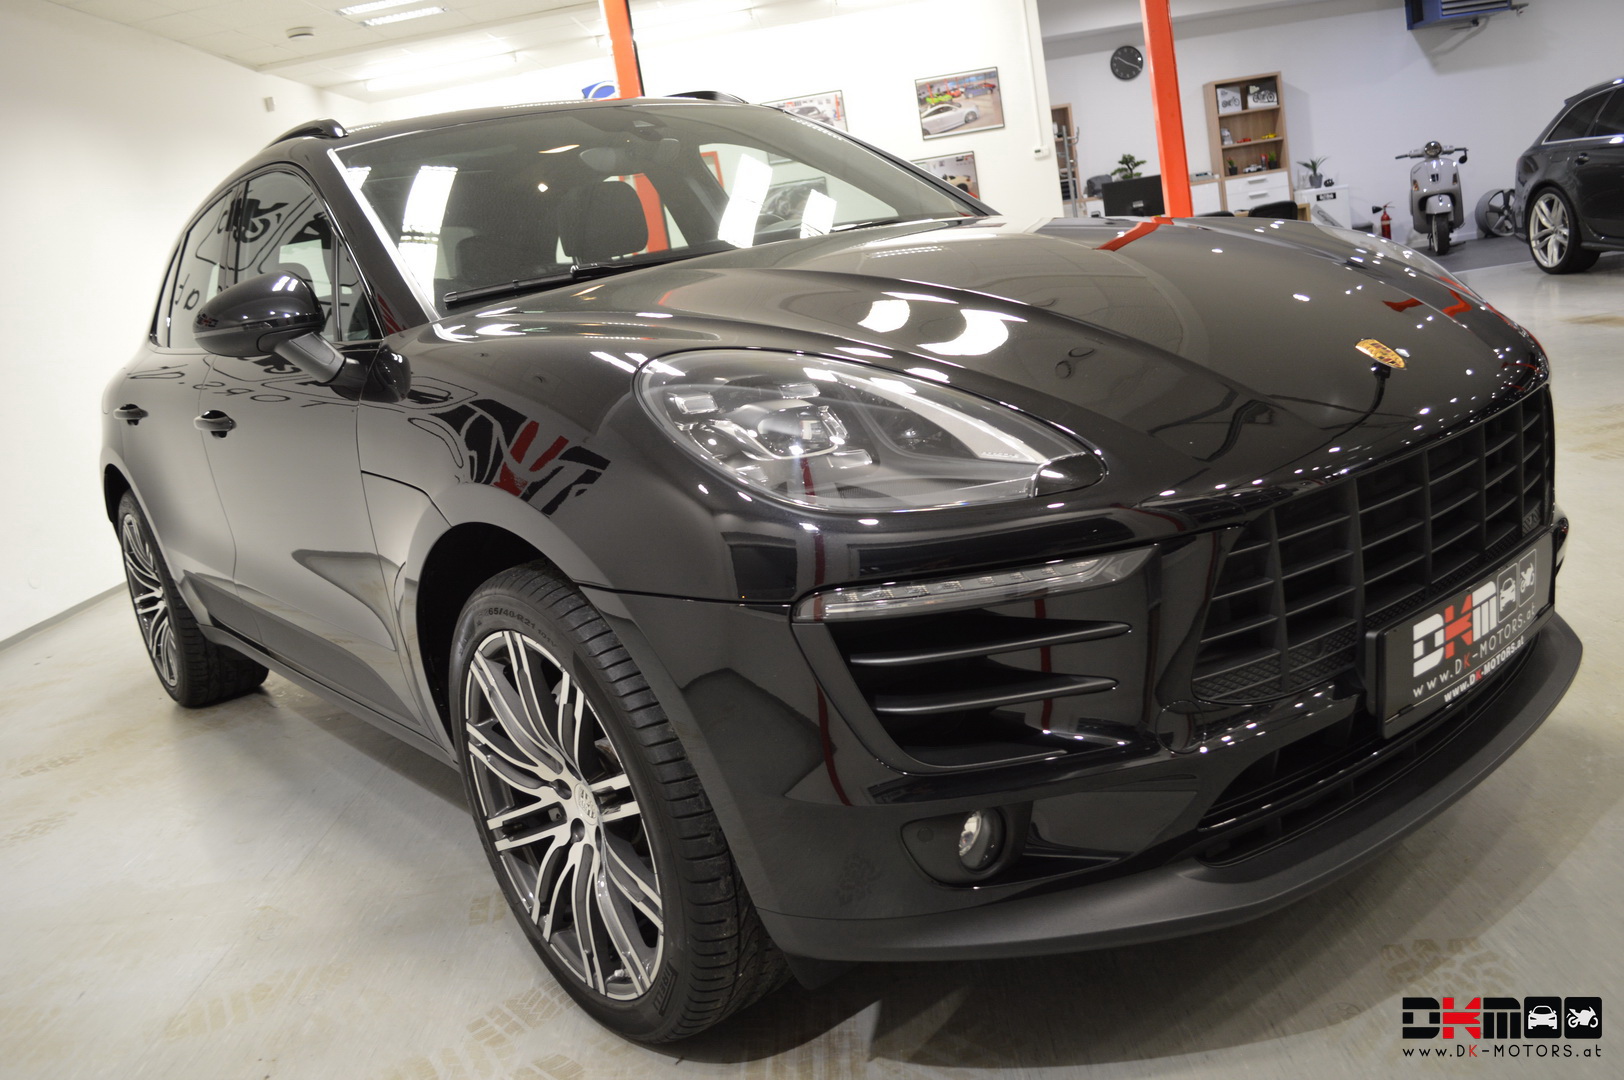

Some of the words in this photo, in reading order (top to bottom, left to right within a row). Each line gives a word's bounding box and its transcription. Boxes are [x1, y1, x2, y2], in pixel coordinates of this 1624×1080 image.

[1413, 581, 1497, 677] DKM
[1413, 604, 1535, 697] www.DK-MOTORS.at
[1444, 635, 1524, 702] www.DK-MOTORS.at
